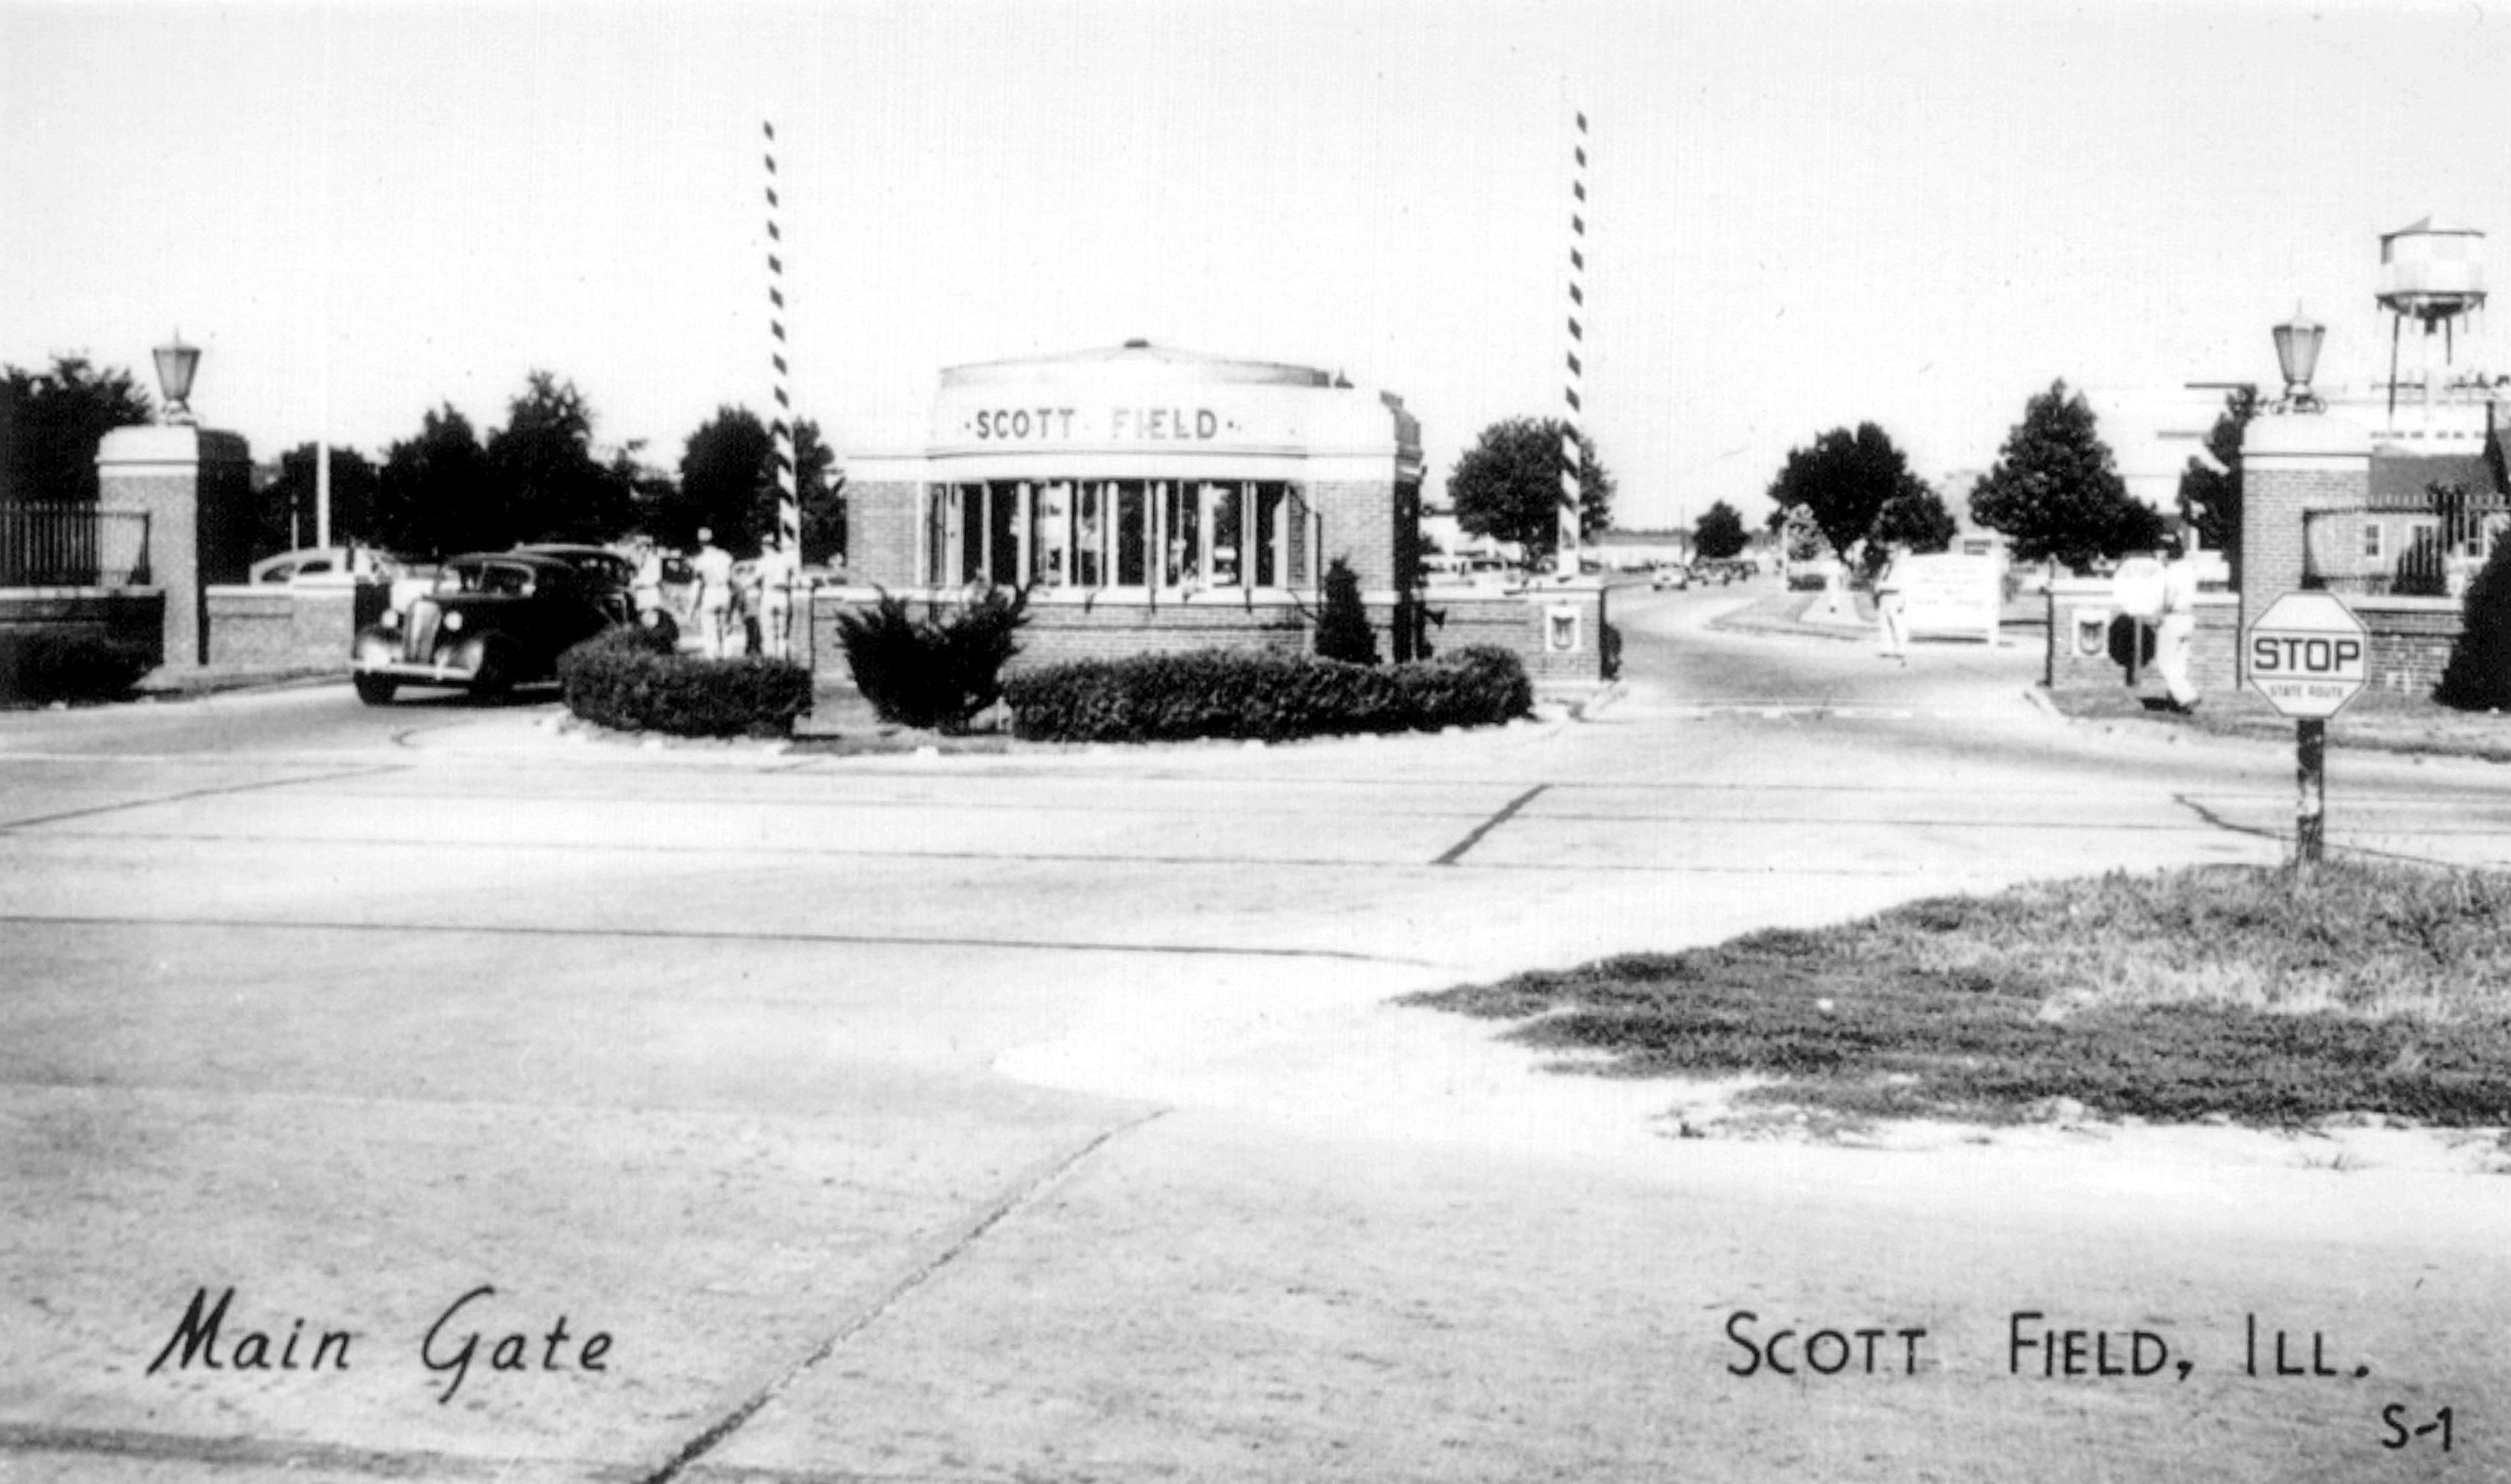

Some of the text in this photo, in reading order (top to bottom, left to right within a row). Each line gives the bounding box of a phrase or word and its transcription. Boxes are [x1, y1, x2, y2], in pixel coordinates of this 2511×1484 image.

[977, 408, 1218, 439] SCOTT FIELD
[2255, 638, 2360, 671] STOP
